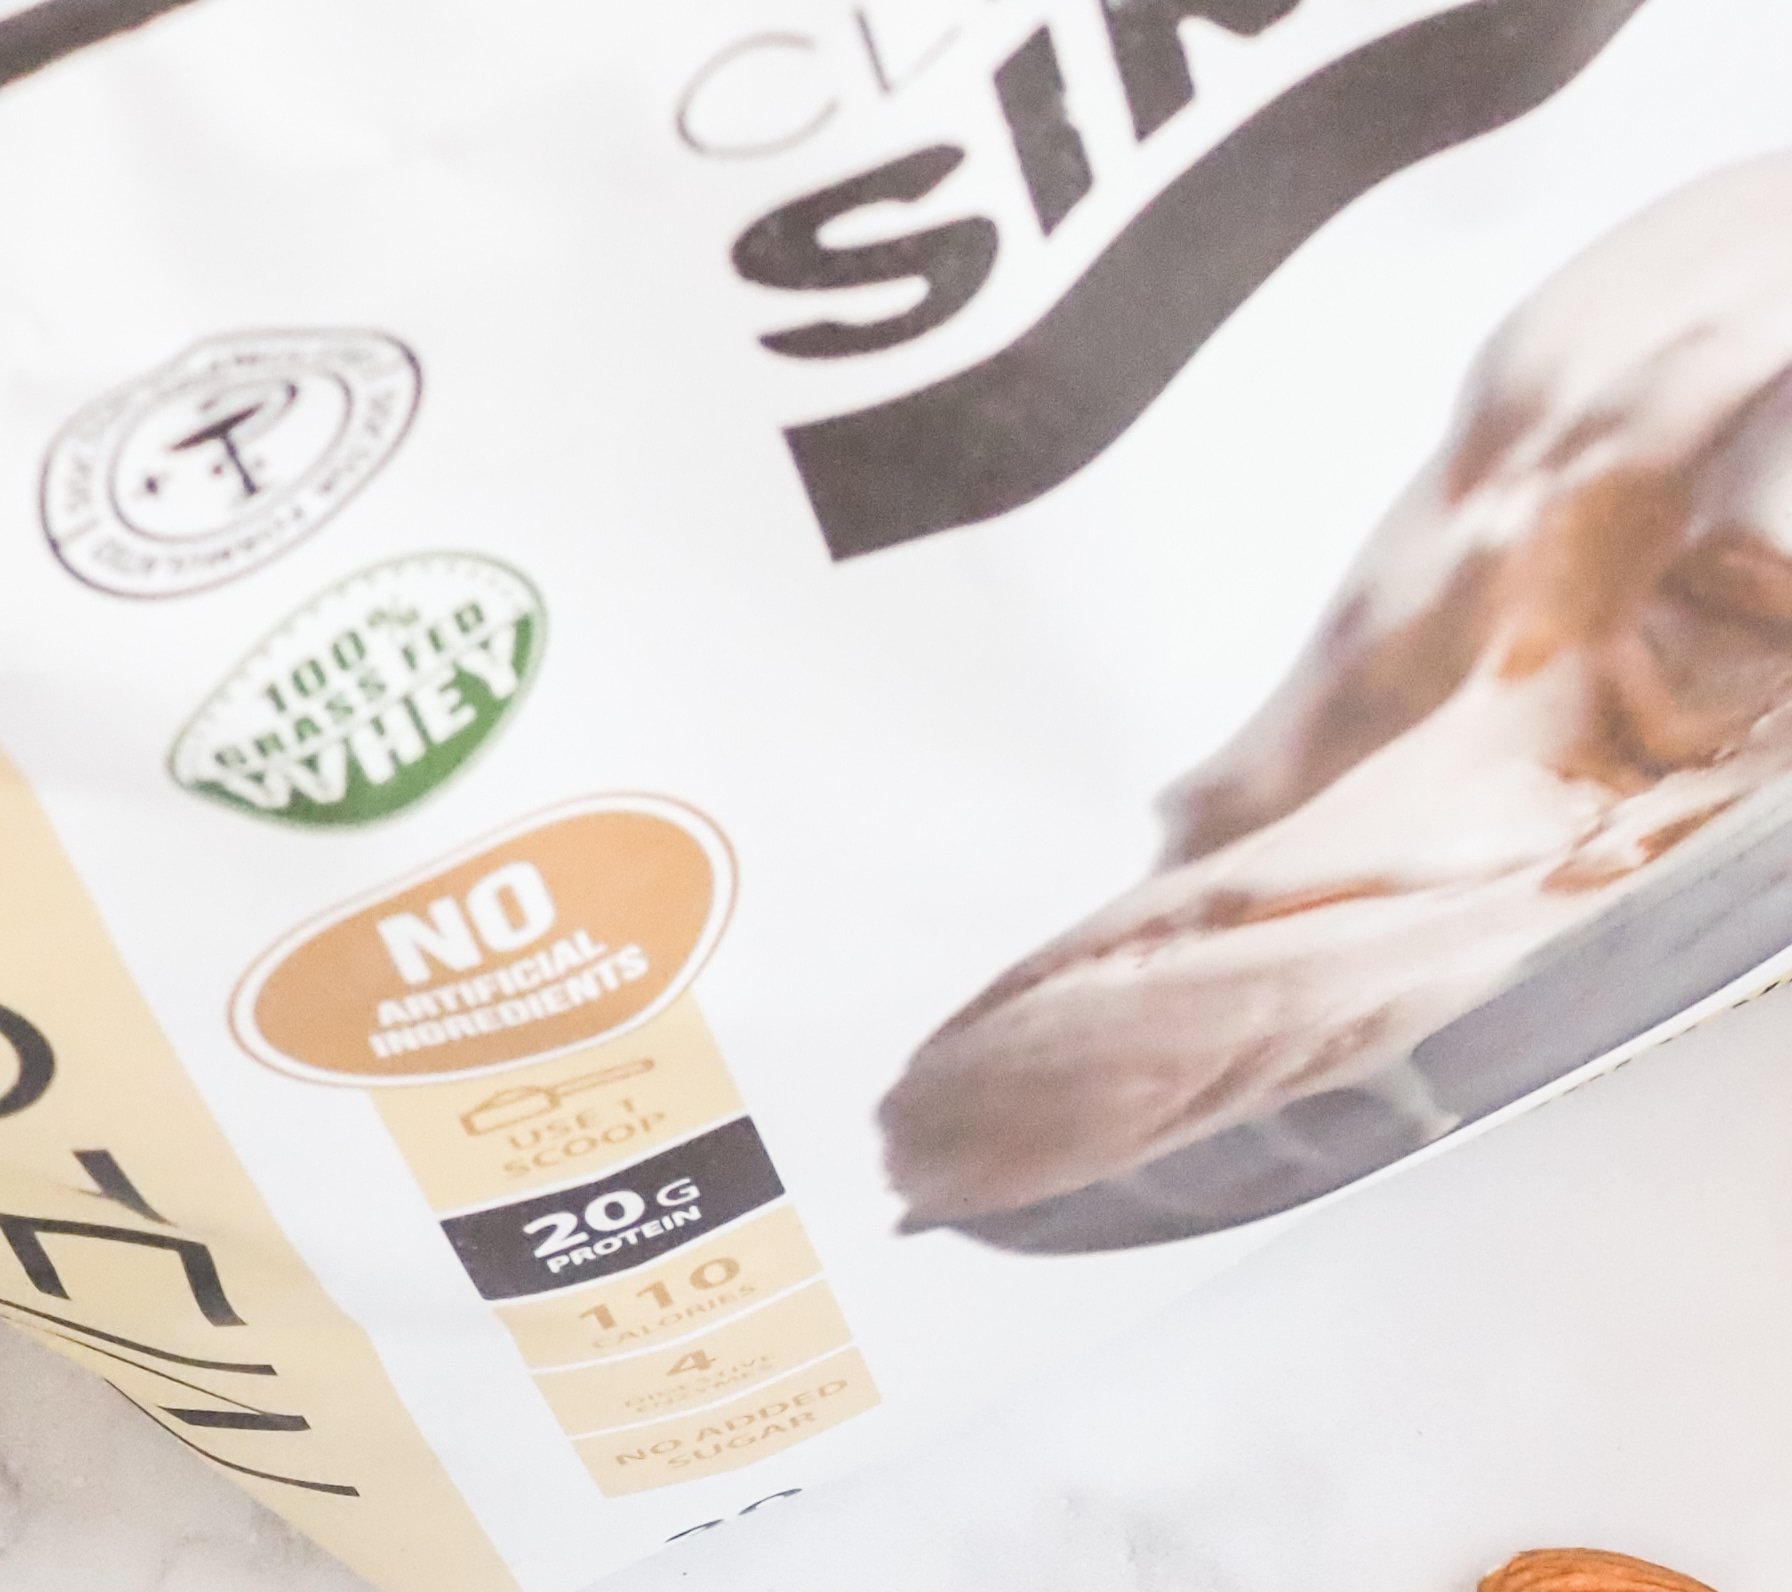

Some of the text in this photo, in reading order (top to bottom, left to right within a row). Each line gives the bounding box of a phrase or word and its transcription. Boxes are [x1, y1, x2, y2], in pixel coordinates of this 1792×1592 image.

[205, 622, 520, 809] WHEY
[375, 859, 557, 986] NO
[367, 943, 650, 1060] INGREDIENTS
[376, 928, 609, 1028] ARTIFICIAL
[502, 1110, 668, 1178] SCOOP
[507, 1106, 598, 1151] USE
[522, 1177, 701, 1259] 20 G
[545, 1205, 703, 1274] PROTEIN
[578, 1256, 741, 1331] 110
[591, 1284, 757, 1349] CALORIES
[666, 1348, 718, 1378] 4
[614, 1438, 683, 1467] NO
[696, 1379, 849, 1443] ADDED
[667, 1411, 818, 1470] SUGAR
